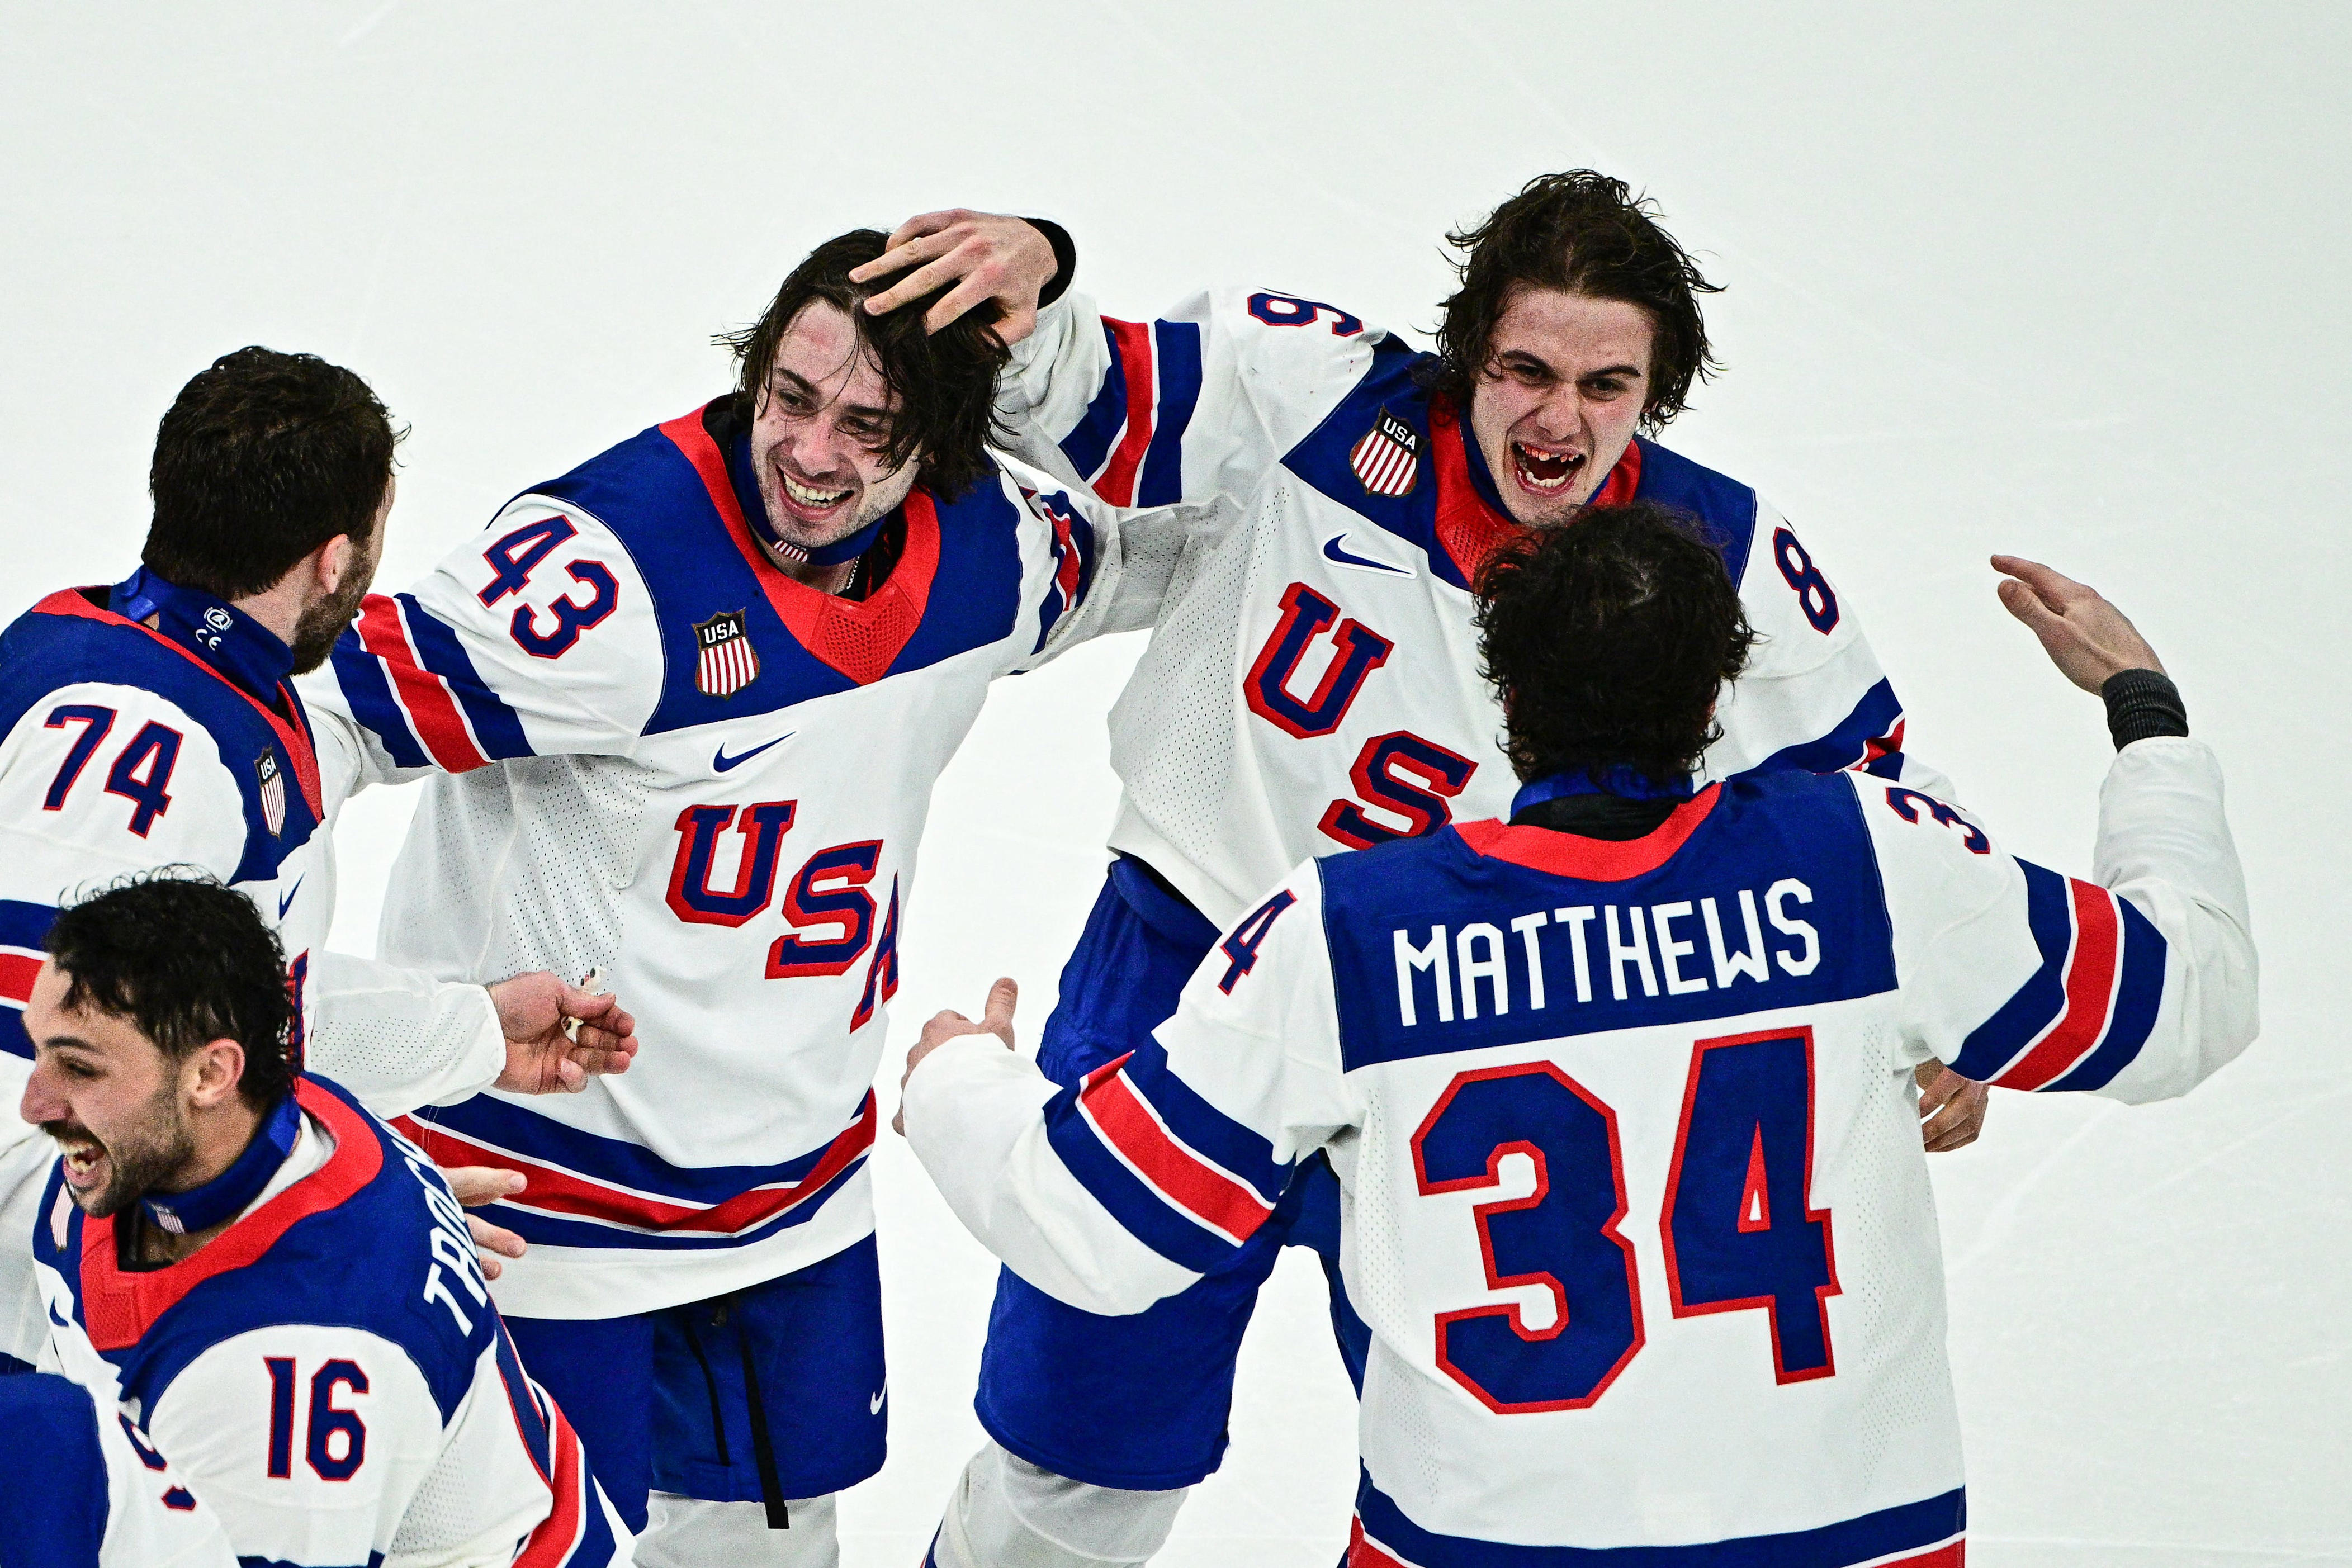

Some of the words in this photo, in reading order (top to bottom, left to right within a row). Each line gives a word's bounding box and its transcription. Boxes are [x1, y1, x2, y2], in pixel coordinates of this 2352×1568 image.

[1247, 286, 1363, 337] 6
[1383, 417, 1416, 451] USA
[477, 514, 619, 659] 43
[704, 619, 739, 644] USA
[1773, 515, 1840, 636] 8
[42, 704, 184, 839] 74
[260, 754, 277, 780] USA
[1394, 878, 1821, 1026] MATTHEWS
[1409, 1025, 1844, 1415] 34
[263, 1356, 370, 1481] 16
